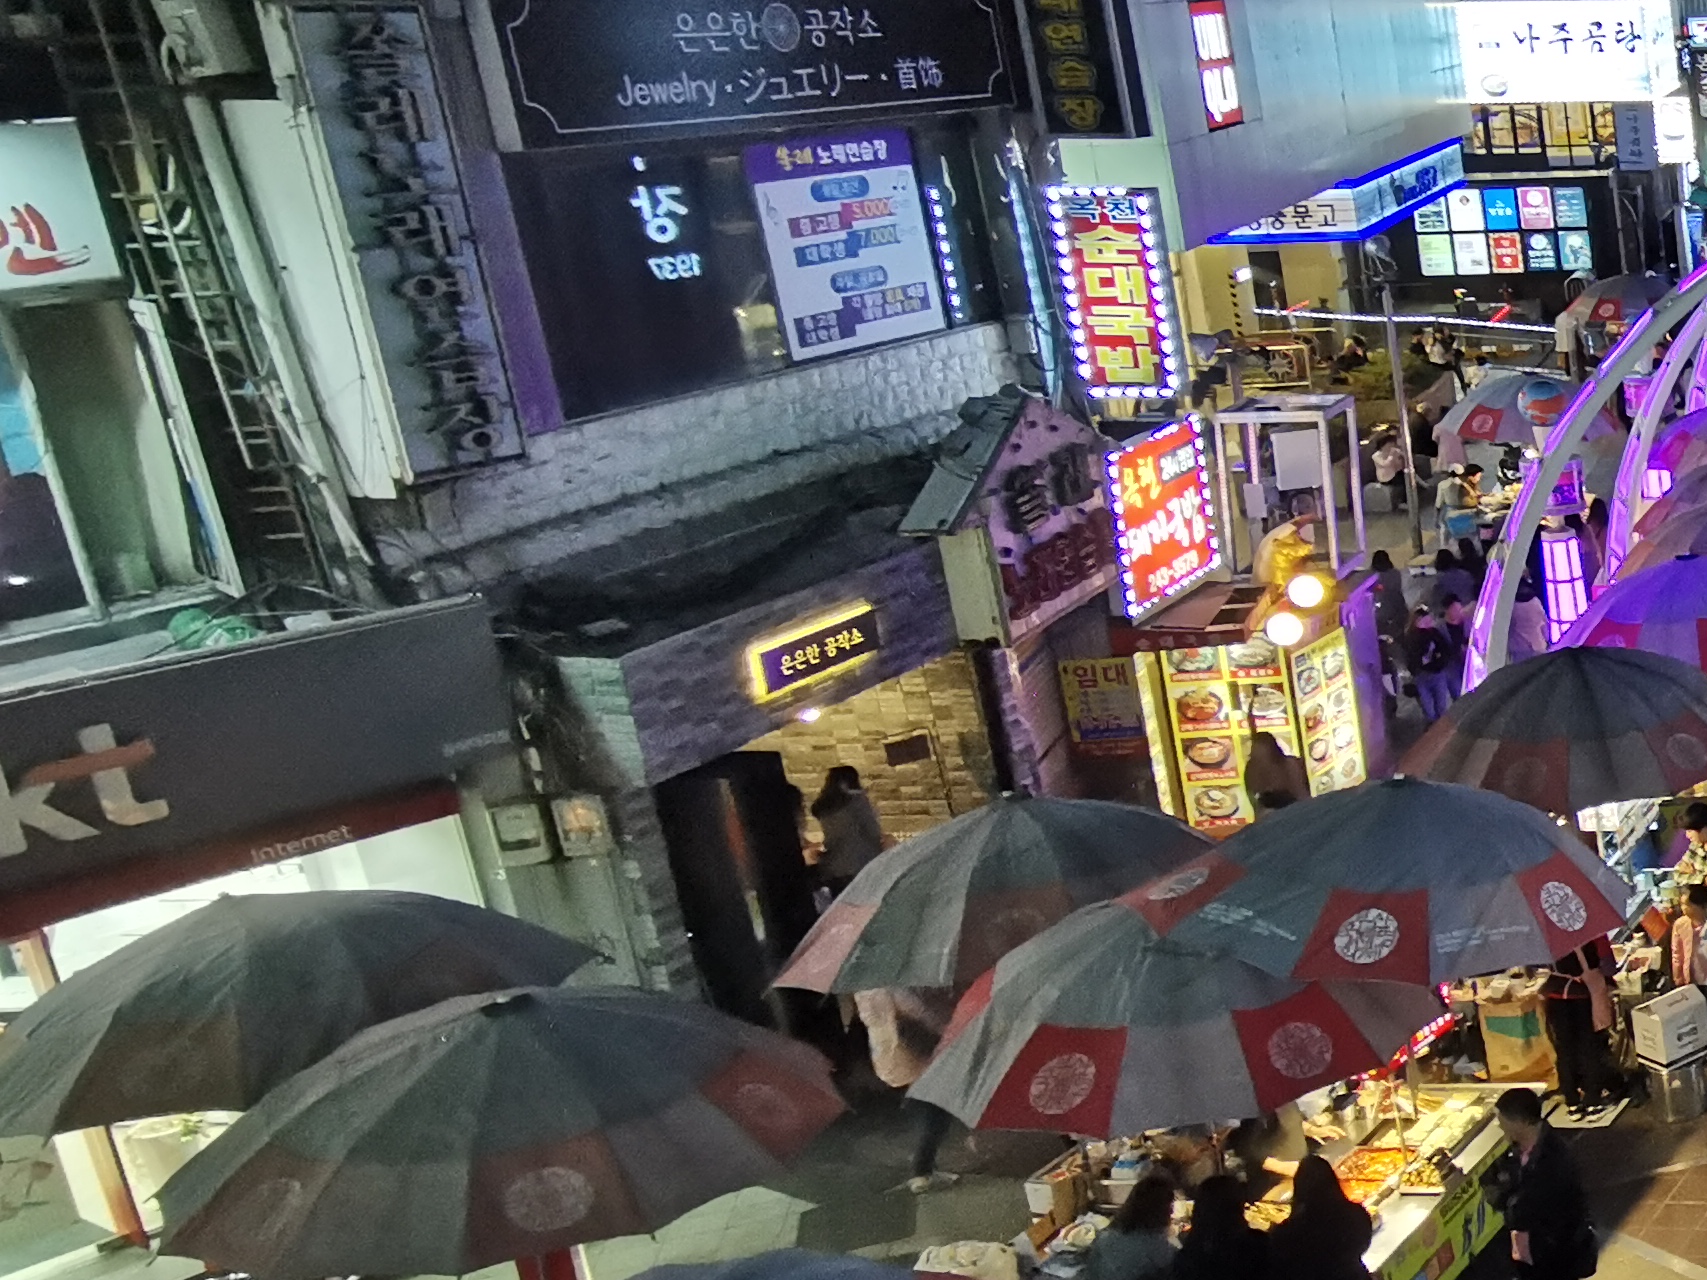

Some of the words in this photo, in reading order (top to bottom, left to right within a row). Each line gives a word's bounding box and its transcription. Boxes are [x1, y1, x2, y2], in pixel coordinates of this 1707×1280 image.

[672, 10, 762, 53] 은은한
[803, 8, 884, 48] 공작소
[1513, 20, 1643, 56] 나주곰탕
[617, 72, 718, 108] Jewelry
[742, 67, 870, 105] ジュエリー
[817, 138, 888, 166] 노래연습장
[1068, 196, 1138, 223] 옥천
[1072, 226, 1161, 387] 순대국밥
[780, 646, 821, 675] 은은한
[823, 626, 866, 657] 공작소
[1075, 664, 1129, 690] 임대
[0, 723, 170, 858] kt
[252, 823, 353, 863] Internet
